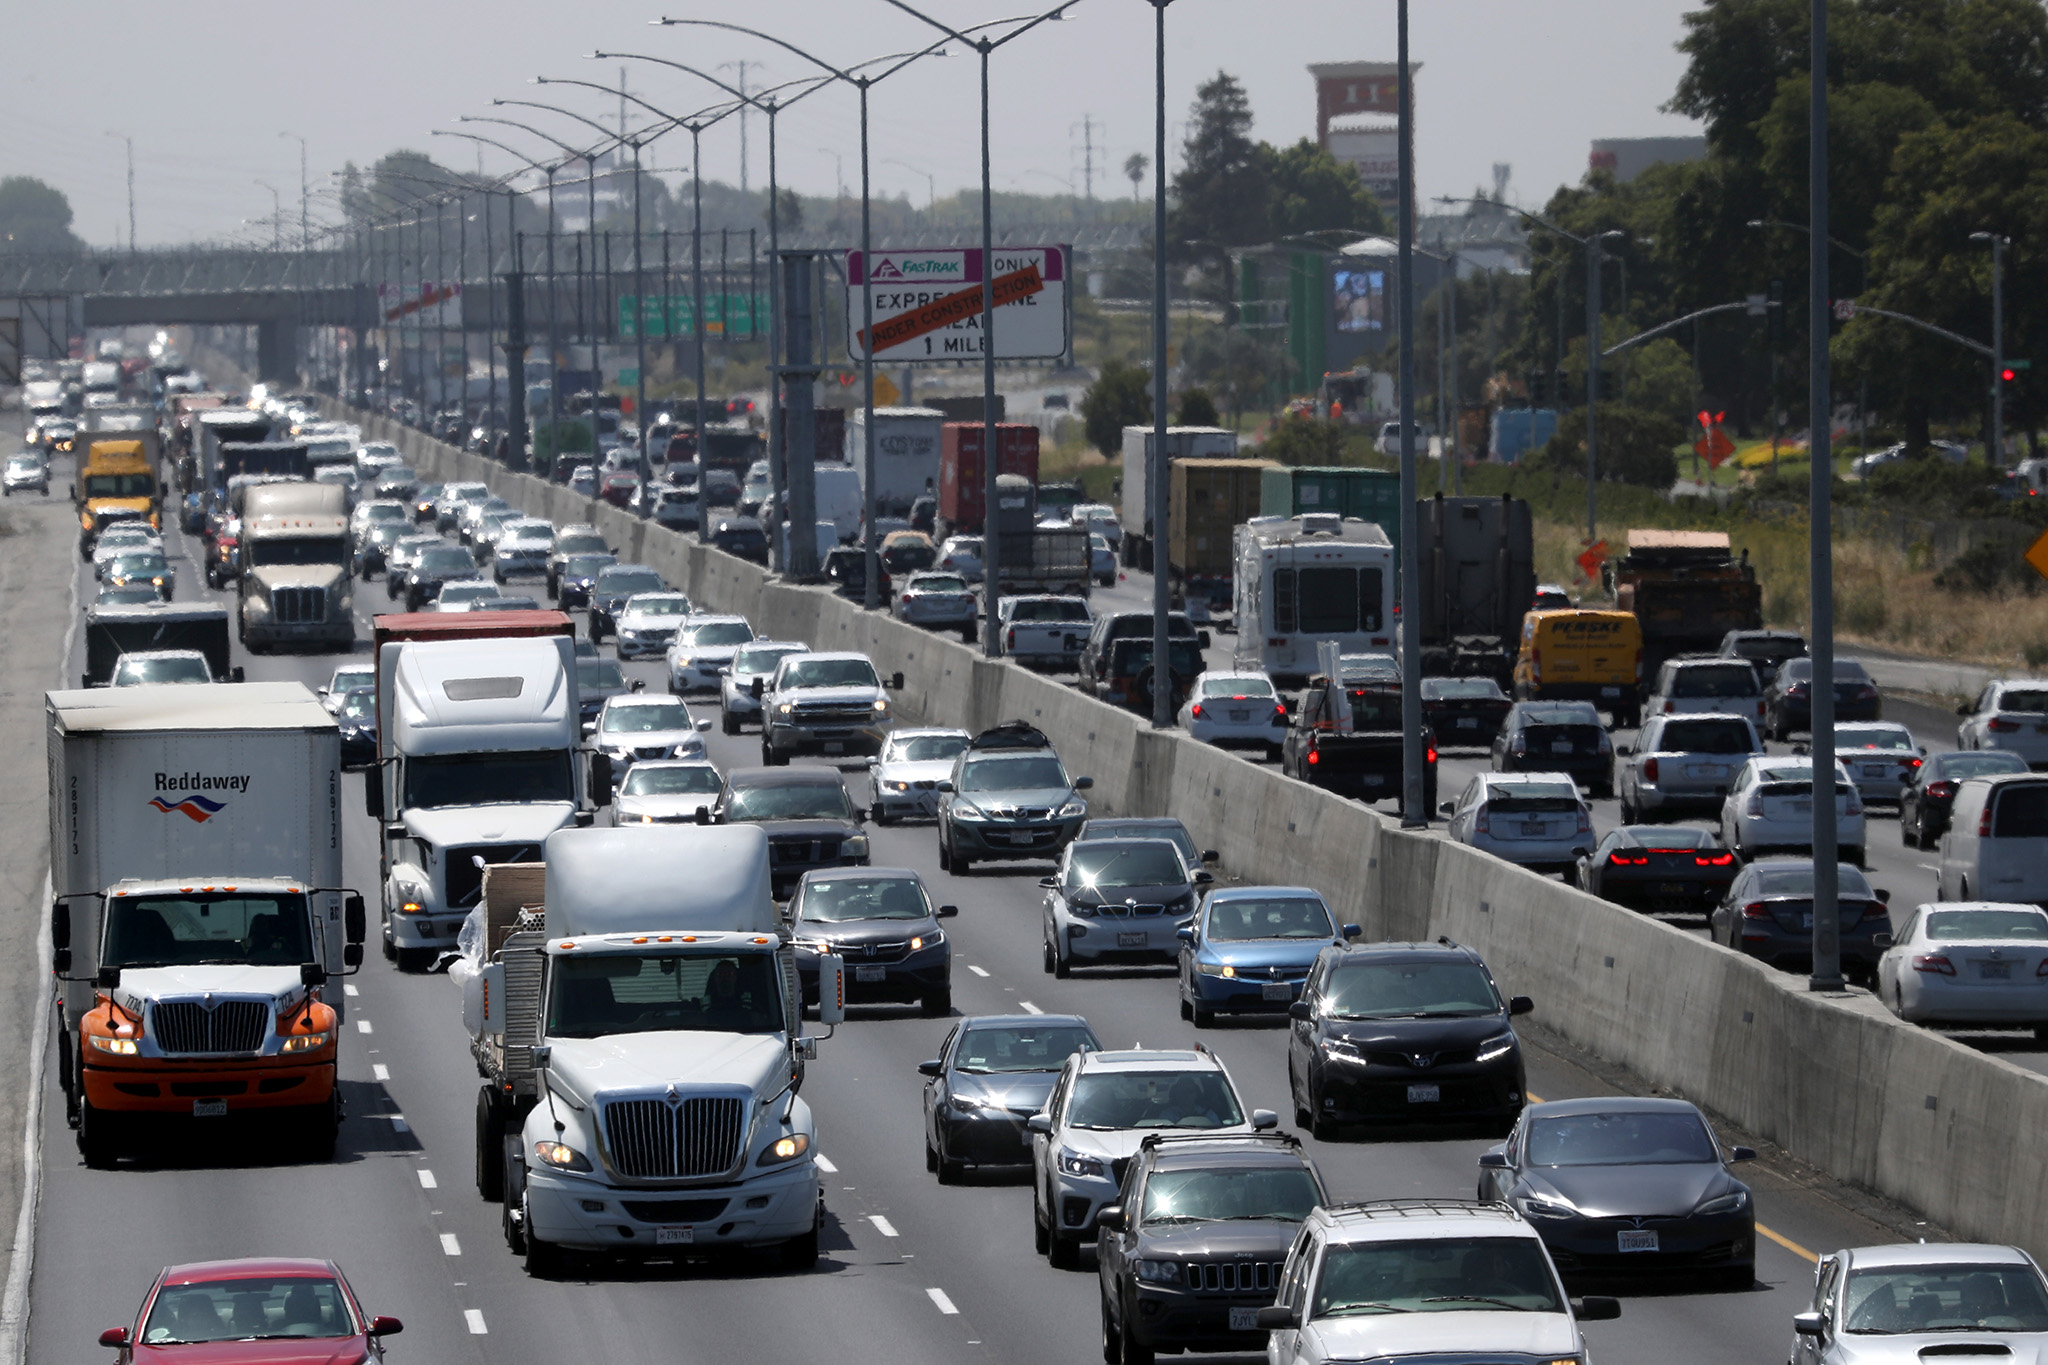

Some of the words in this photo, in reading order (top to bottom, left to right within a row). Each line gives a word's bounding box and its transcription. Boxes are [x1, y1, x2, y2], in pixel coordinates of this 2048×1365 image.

[994, 256, 1041, 271] ONLY
[876, 291, 957, 310] EXPRE
[921, 275, 1036, 326] CONSTRCTION
[925, 336, 932, 355] 1
[943, 337, 985, 353] MILE
[1551, 620, 1622, 634] PENSKE
[154, 771, 251, 793] Reddaway
[70, 775, 79, 855] 289173
[329, 769, 337, 849] 289173
[1234, 1252, 1254, 1260] Jeep
[1233, 1315, 1257, 1327] 7JYL
